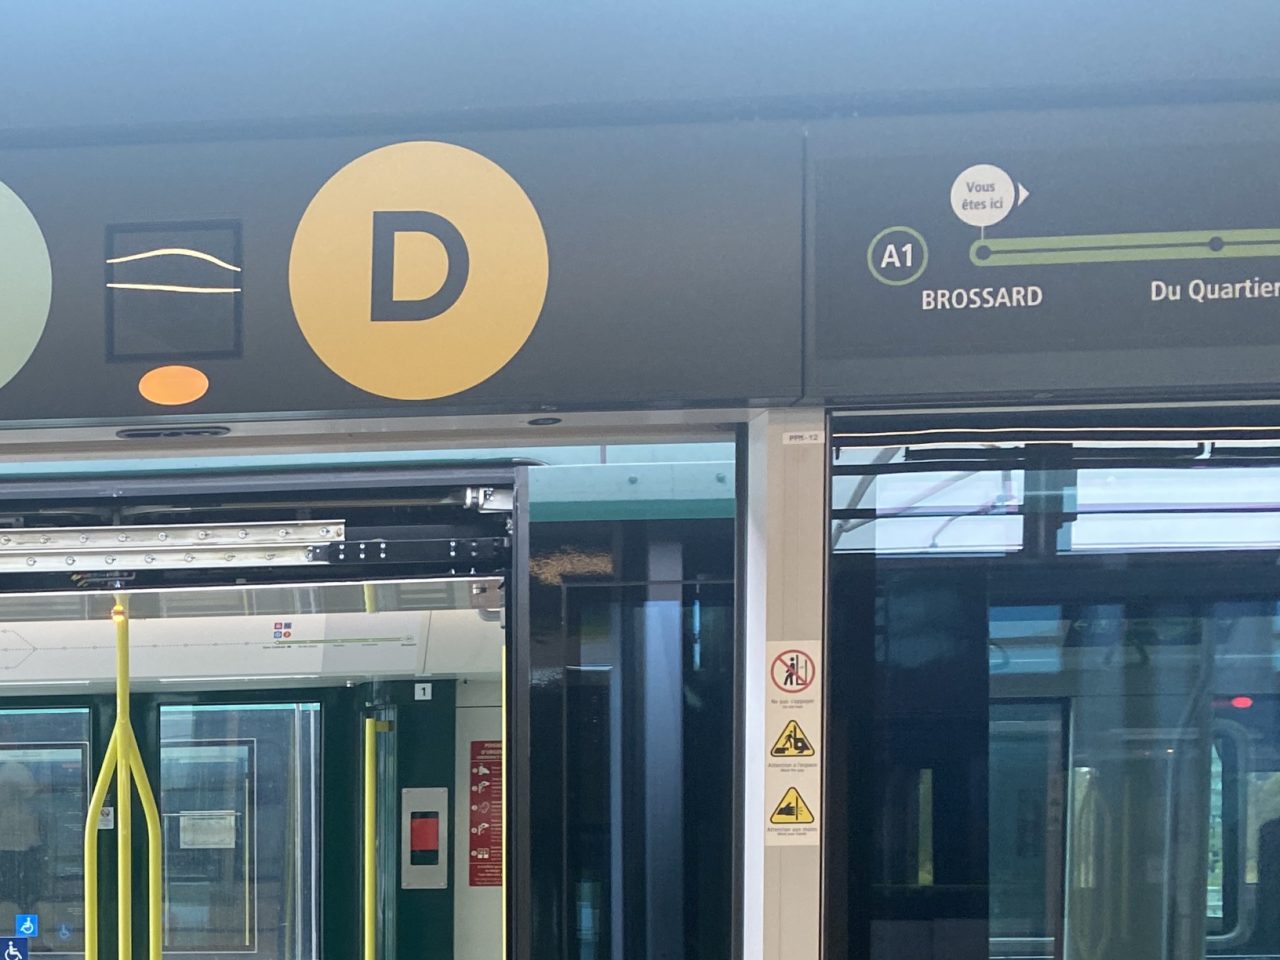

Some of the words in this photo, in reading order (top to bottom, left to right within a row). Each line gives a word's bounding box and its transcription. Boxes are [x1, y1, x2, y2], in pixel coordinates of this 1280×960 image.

[966, 182, 995, 193] Vous
[962, 199, 986, 210] êtes
[990, 197, 1004, 209] ici
[371, 211, 470, 322] D
[880, 243, 913, 269] A1
[922, 285, 1043, 310] BROSSARD
[1150, 280, 1181, 302] Du
[1188, 276, 1280, 303] Quartier
[421, 686, 426, 697] 1
